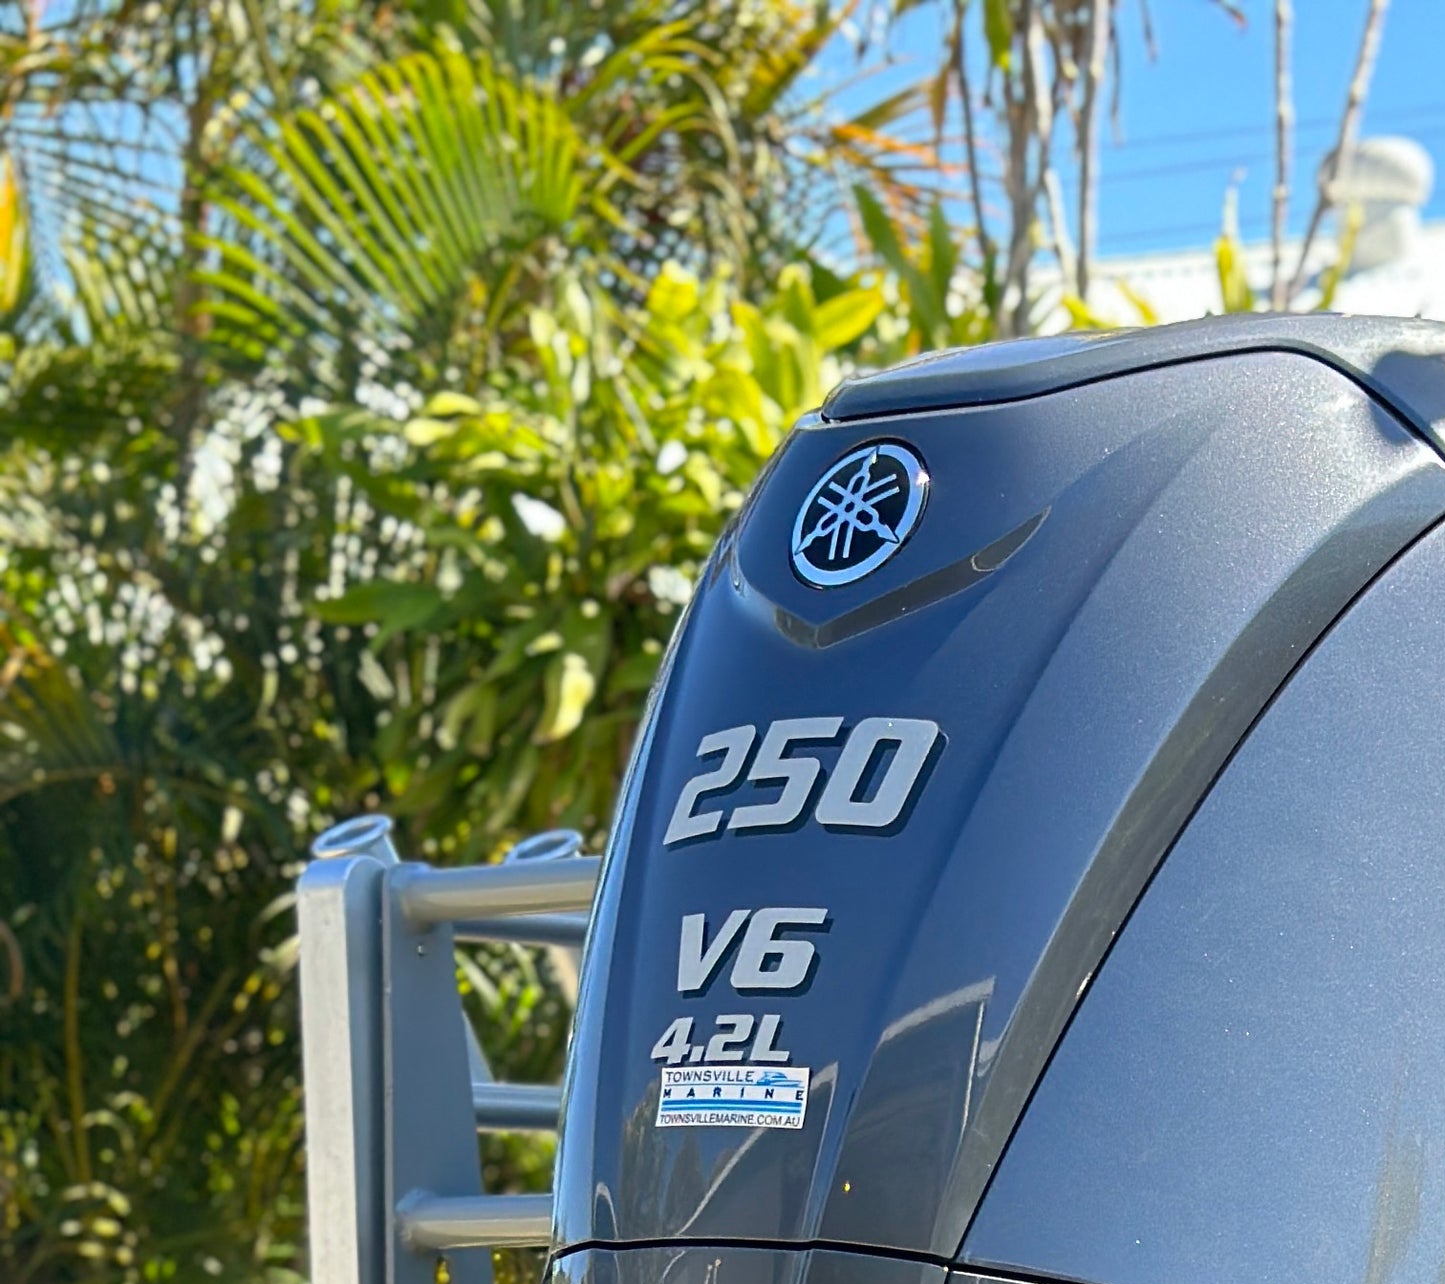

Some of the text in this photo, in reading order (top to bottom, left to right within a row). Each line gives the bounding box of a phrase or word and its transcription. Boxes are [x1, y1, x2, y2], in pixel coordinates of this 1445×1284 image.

[663, 717, 946, 846] 250
[677, 908, 828, 992] V6
[651, 1014, 790, 1064] 4.2L
[665, 1070, 755, 1084] TOWNSVILLE
[663, 1087, 805, 1102] MARINE
[659, 1113, 801, 1127] TOWNSVILLEMARINE.COM.AU
